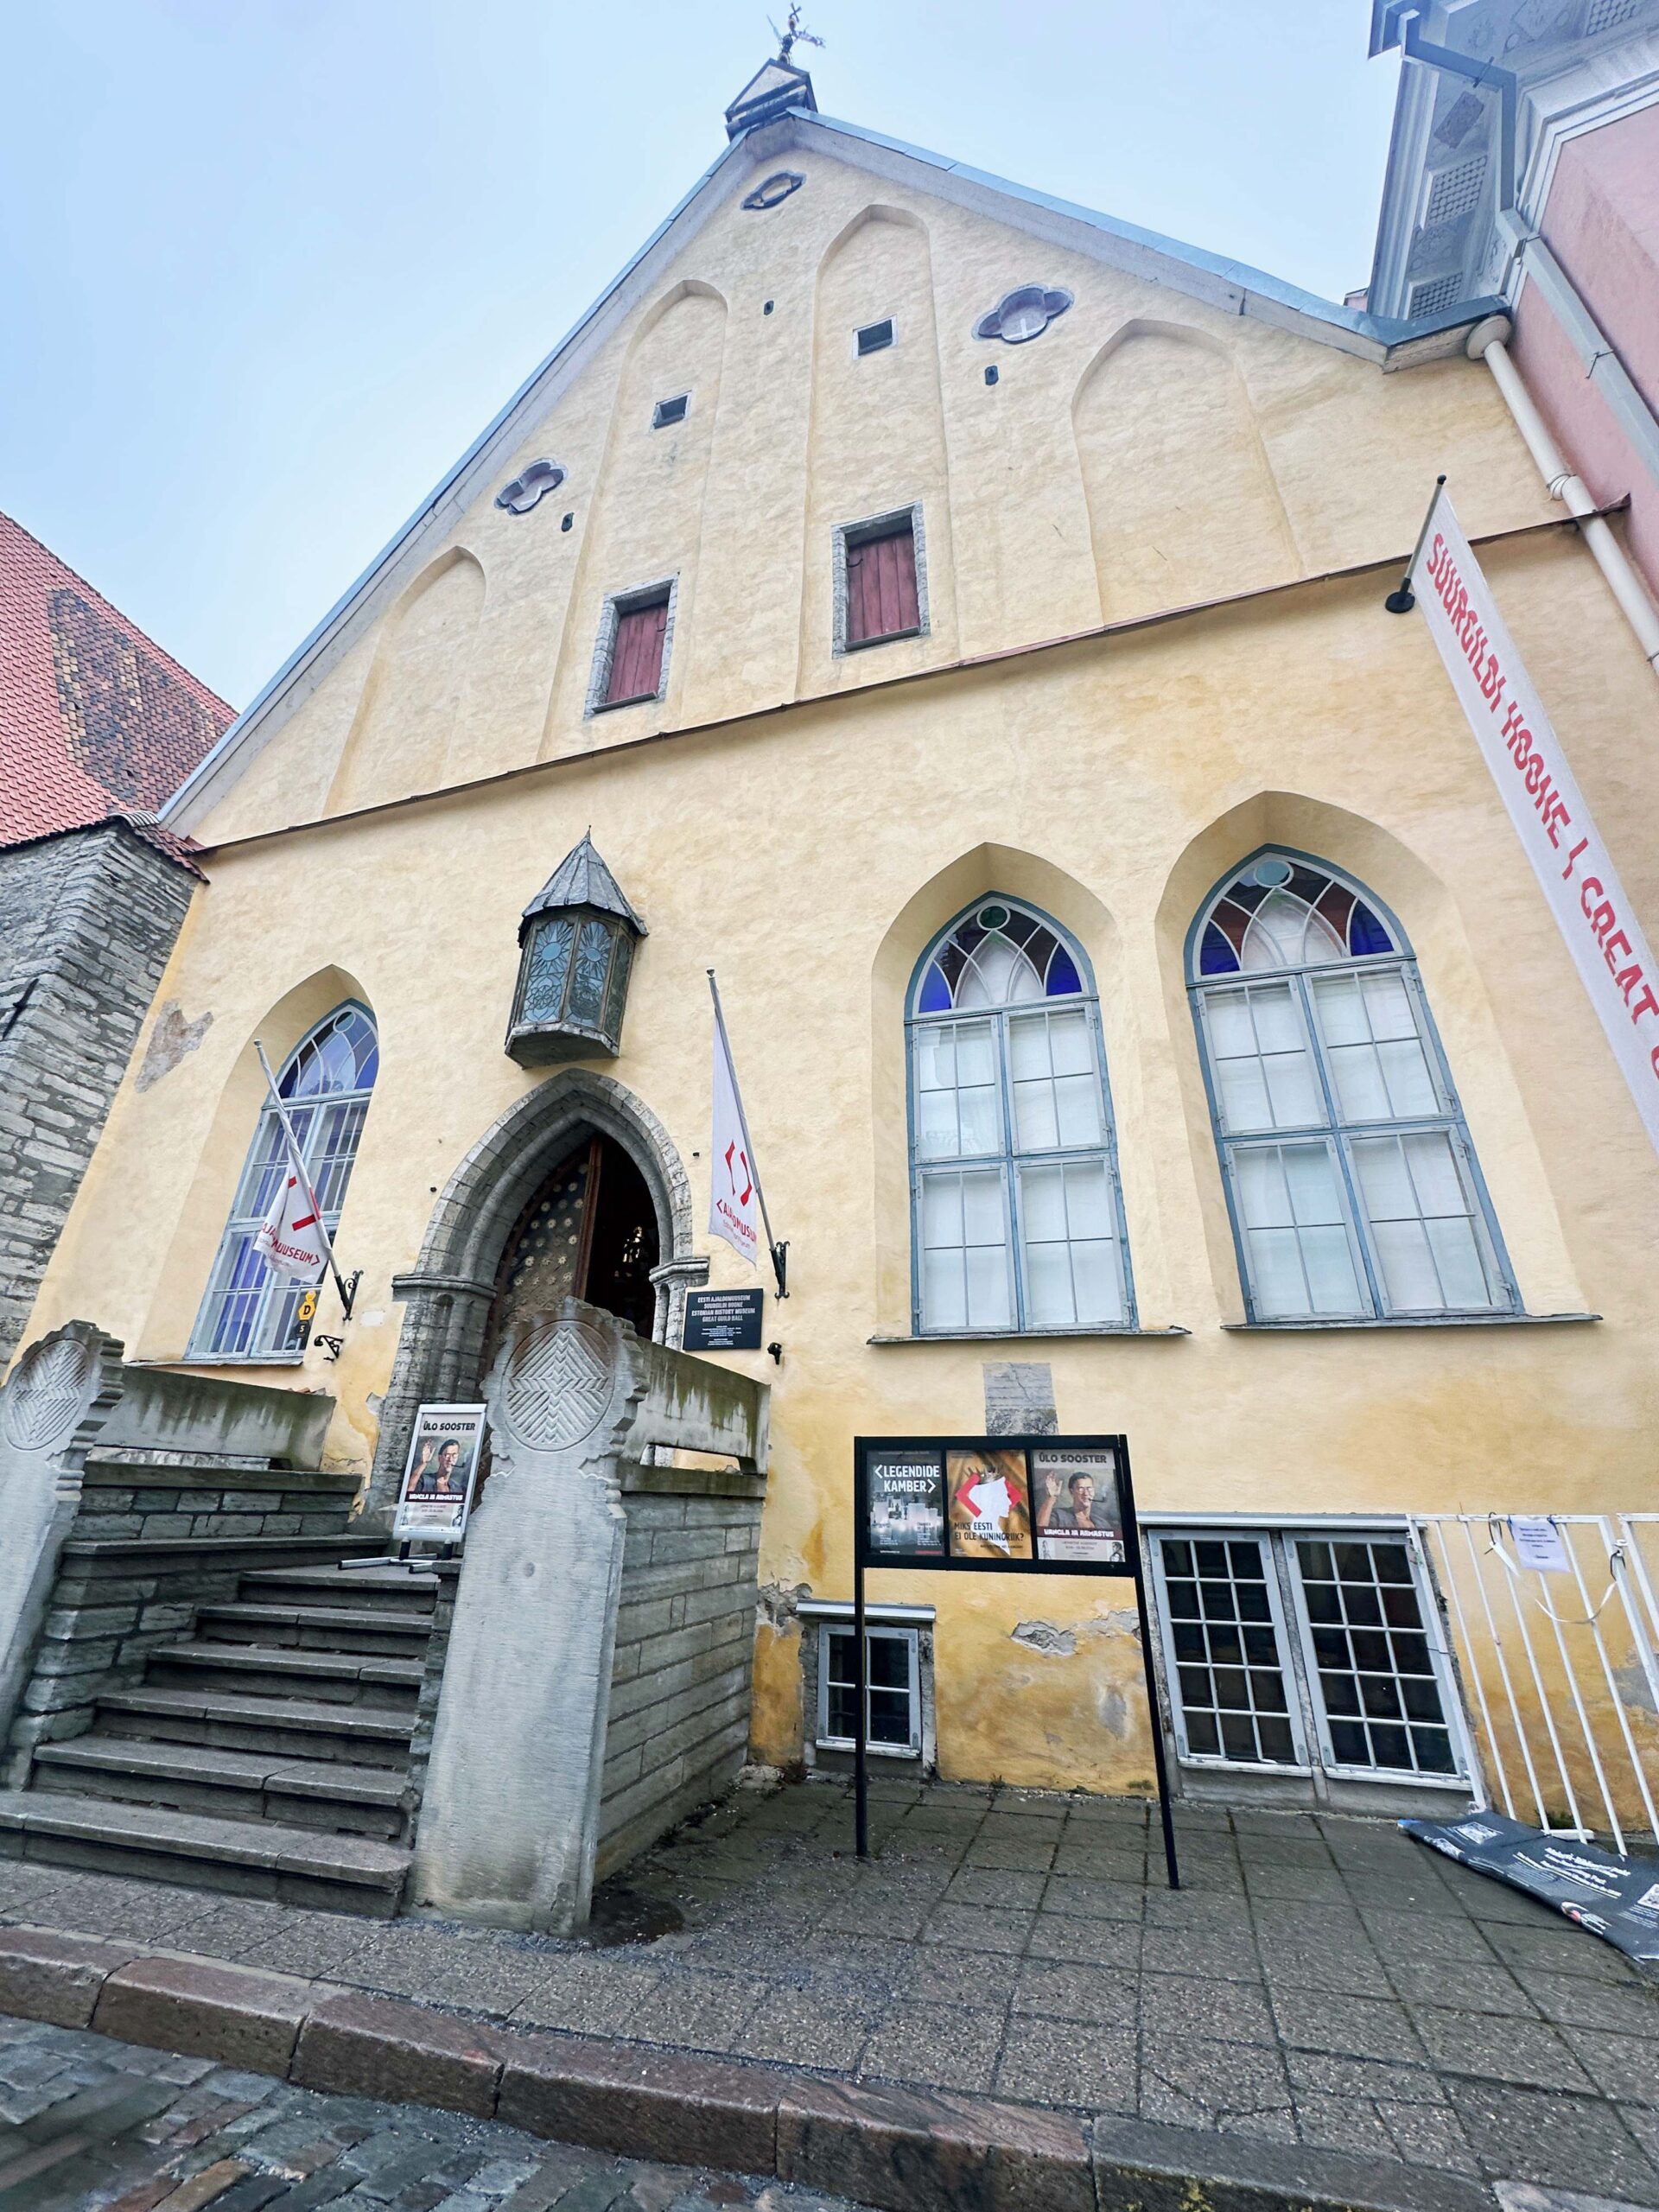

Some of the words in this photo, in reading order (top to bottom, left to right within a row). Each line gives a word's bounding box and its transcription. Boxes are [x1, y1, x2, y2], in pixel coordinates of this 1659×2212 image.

[1426, 531, 1505, 713] SUURGILDI
[1501, 702, 1573, 849] HOONE
[1580, 876, 1659, 1026] GREAT
[303, 1305, 311, 1315] D
[423, 1421, 438, 1431] ÜLO
[440, 1422, 476, 1431] SOOSTER
[1039, 1452, 1058, 1463] ÜLO
[1061, 1454, 1107, 1463] SOOSTER
[954, 1522, 971, 1530] MIKS
[973, 1522, 993, 1530] EESTI
[954, 1532, 962, 1541] EI
[964, 1532, 976, 1541] OLE
